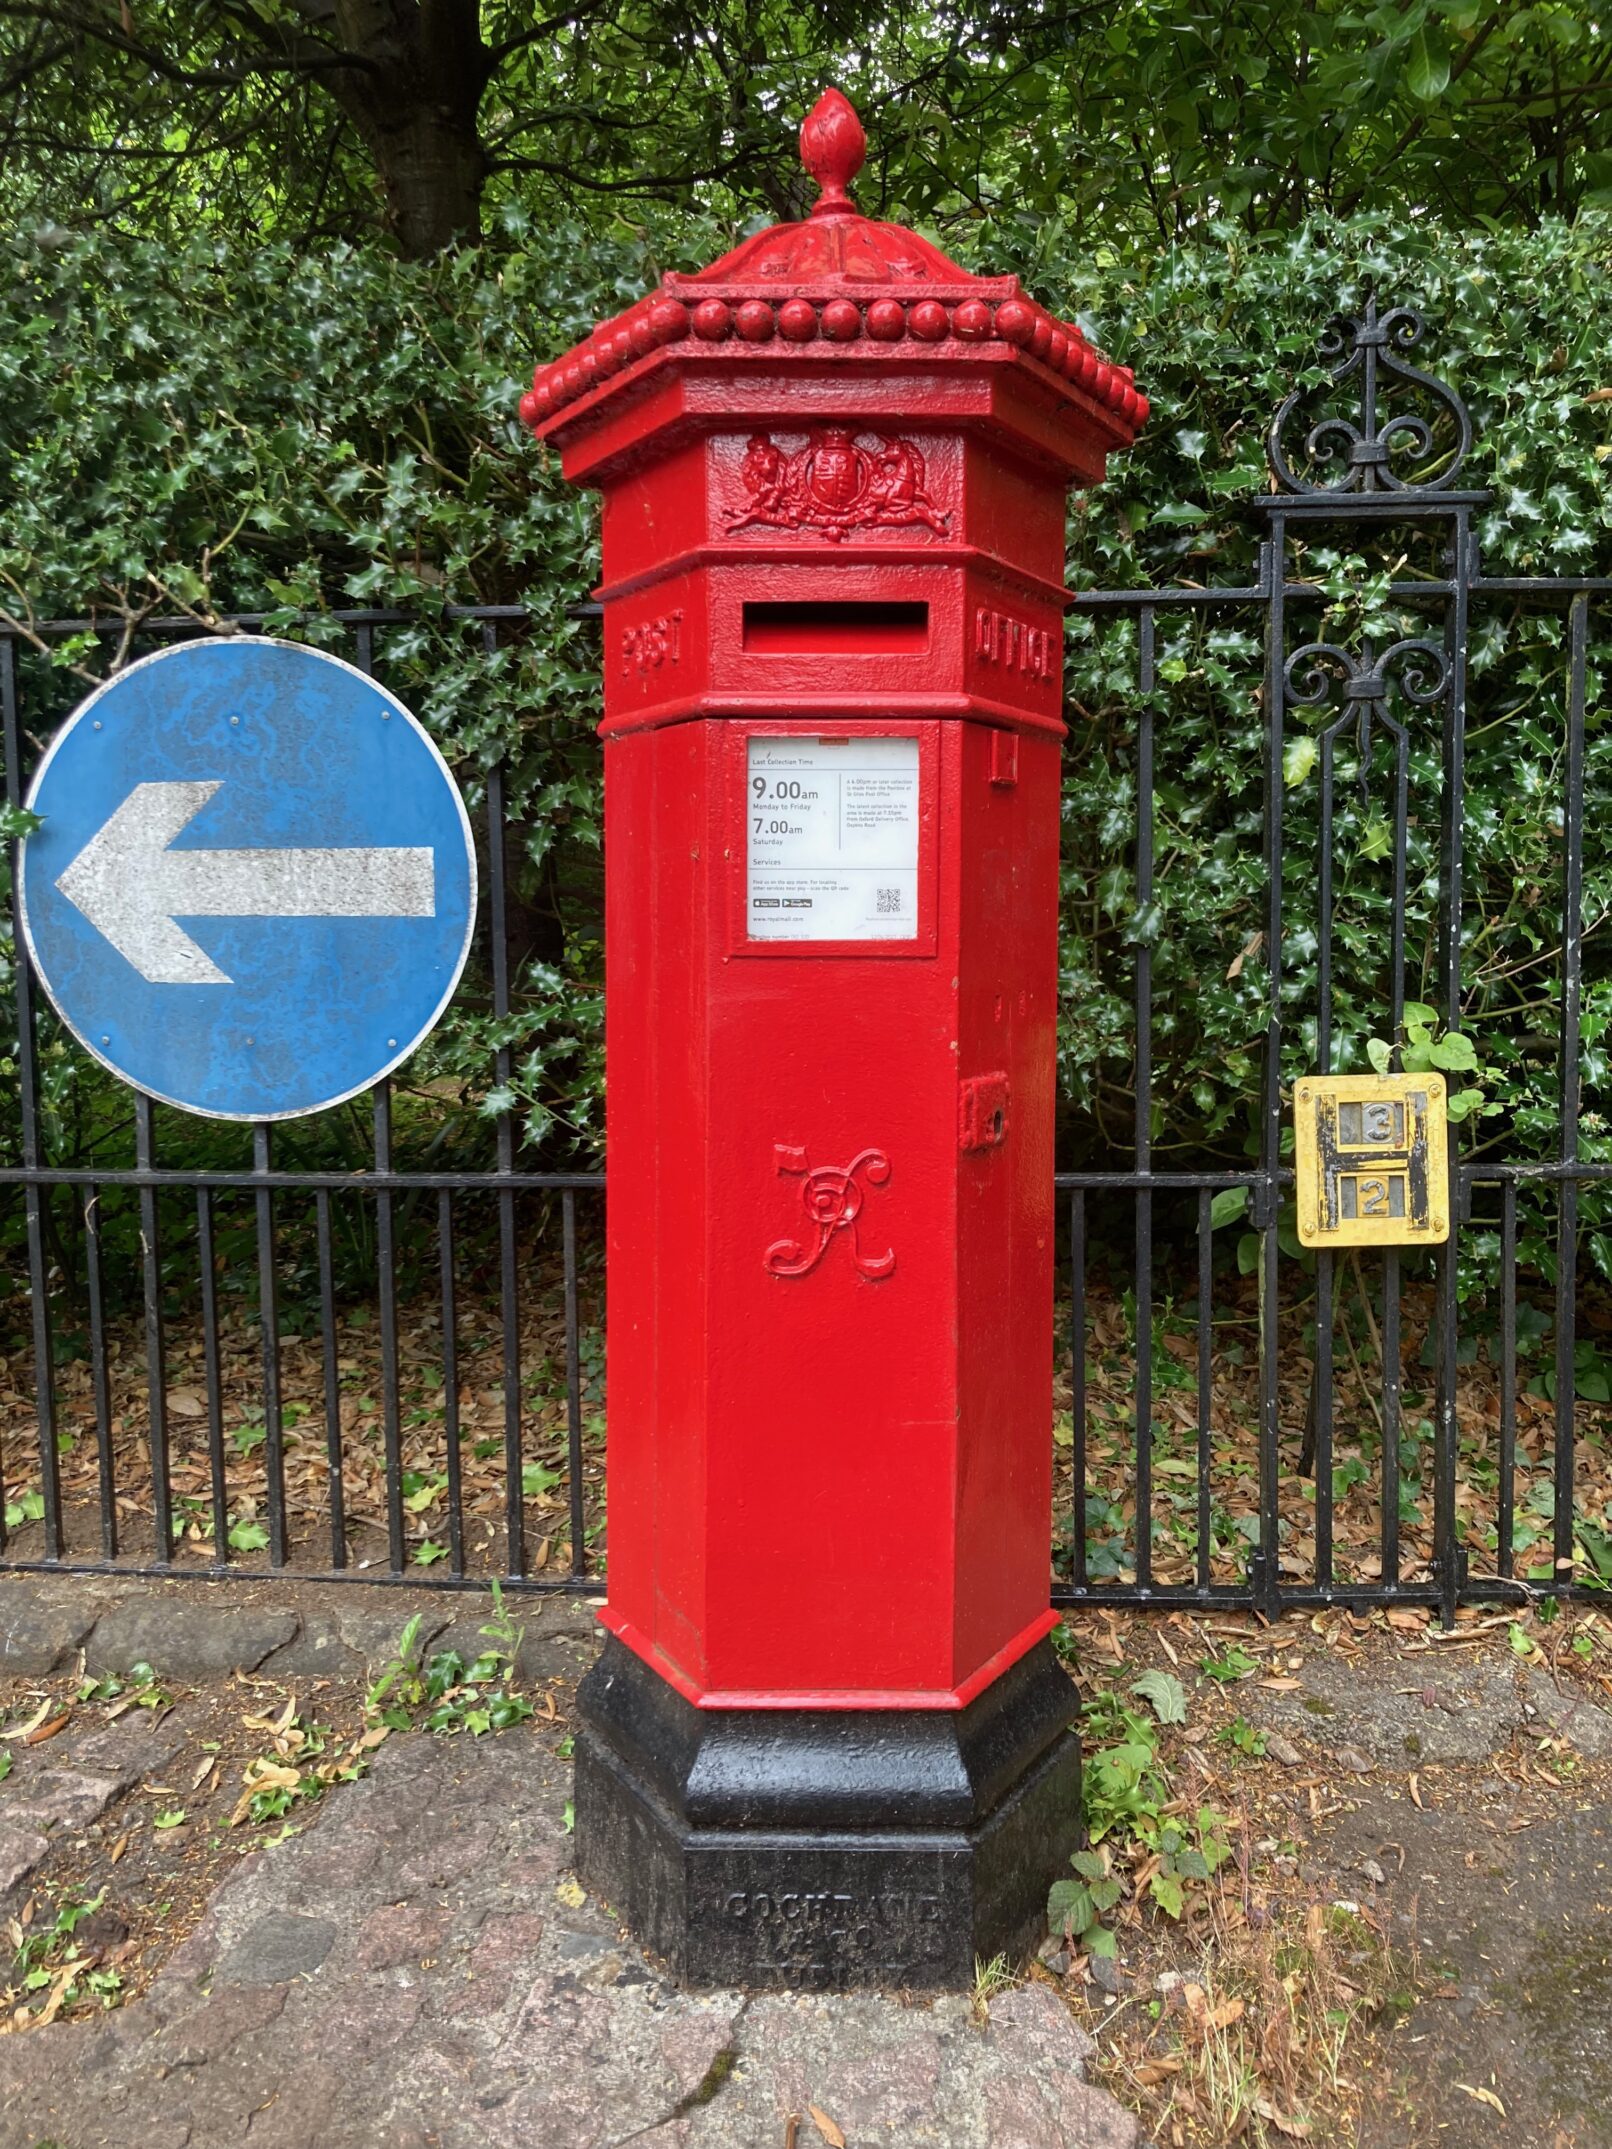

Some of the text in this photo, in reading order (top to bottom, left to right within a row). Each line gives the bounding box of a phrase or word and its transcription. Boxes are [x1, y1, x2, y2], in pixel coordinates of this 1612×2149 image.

[620, 607, 685, 678] POST
[975, 607, 1055, 680] OFFICE
[752, 758, 813, 766] Last Collection Time
[753, 803, 812, 811] Monday to Friday
[753, 838, 784, 846] Saturday
[1366, 1104, 1392, 1141] 3
[1359, 1179, 1389, 1215] 2
